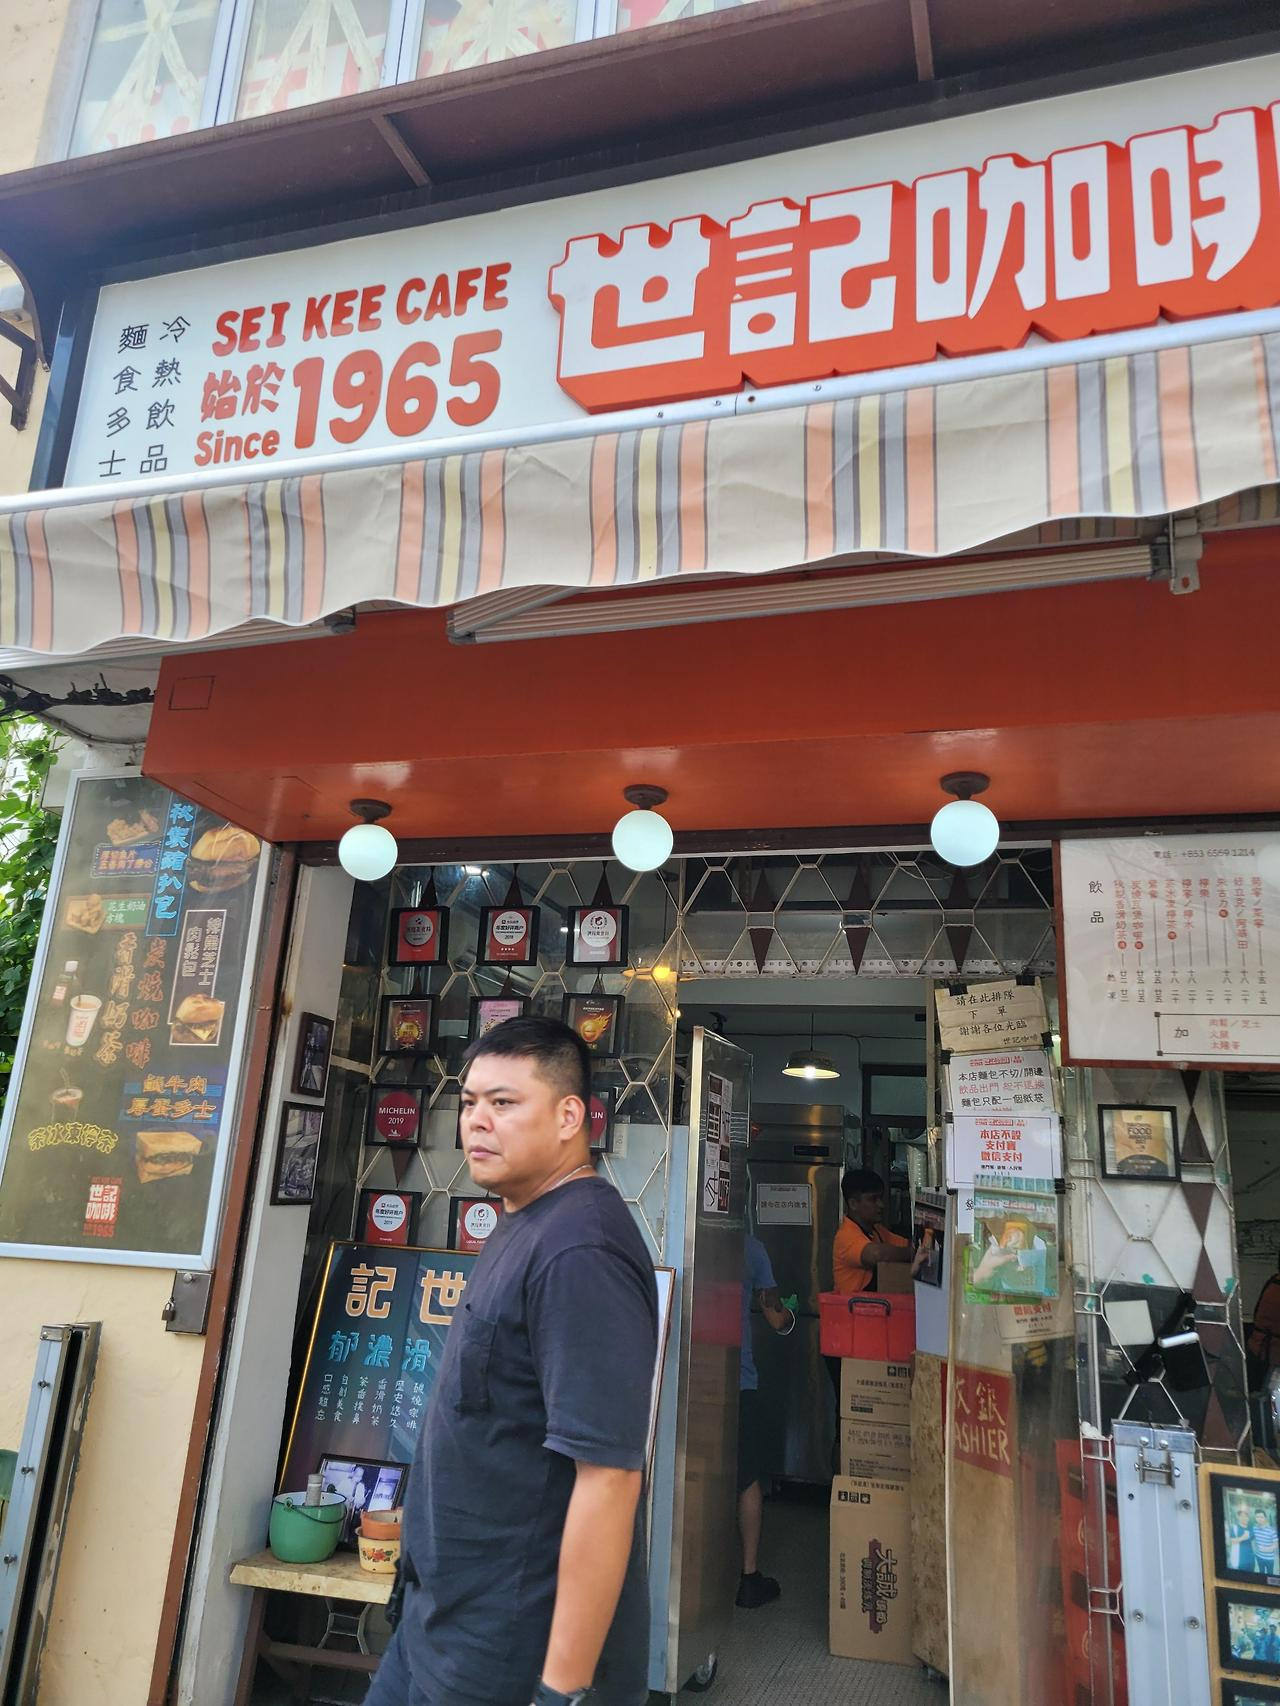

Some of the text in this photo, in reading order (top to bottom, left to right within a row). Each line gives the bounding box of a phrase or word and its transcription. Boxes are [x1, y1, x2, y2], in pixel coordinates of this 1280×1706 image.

[212, 262, 512, 357] SEI KEE CAFE
[140, 316, 191, 474] 冷熱飲品
[200, 328, 503, 449] 始於 1965
[99, 324, 150, 477] 麵食多士
[194, 429, 280, 467] Since
[1089, 880, 1104, 923] 飲品
[955, 990, 1015, 1006] 請在此排隊
[969, 1010, 978, 1019] 下
[960, 1019, 1027, 1035] 謝謝各位光臨
[1174, 1027, 1189, 1038] 加
[378, 1106, 416, 1115] MICHELIN
[388, 1117, 404, 1125] 2019
[980, 1129, 1021, 1141] 本店不設
[986, 1140, 1017, 1151] 支付寶
[981, 1151, 1022, 1162] 微信支付
[955, 1421, 1010, 1466] ASHIER
